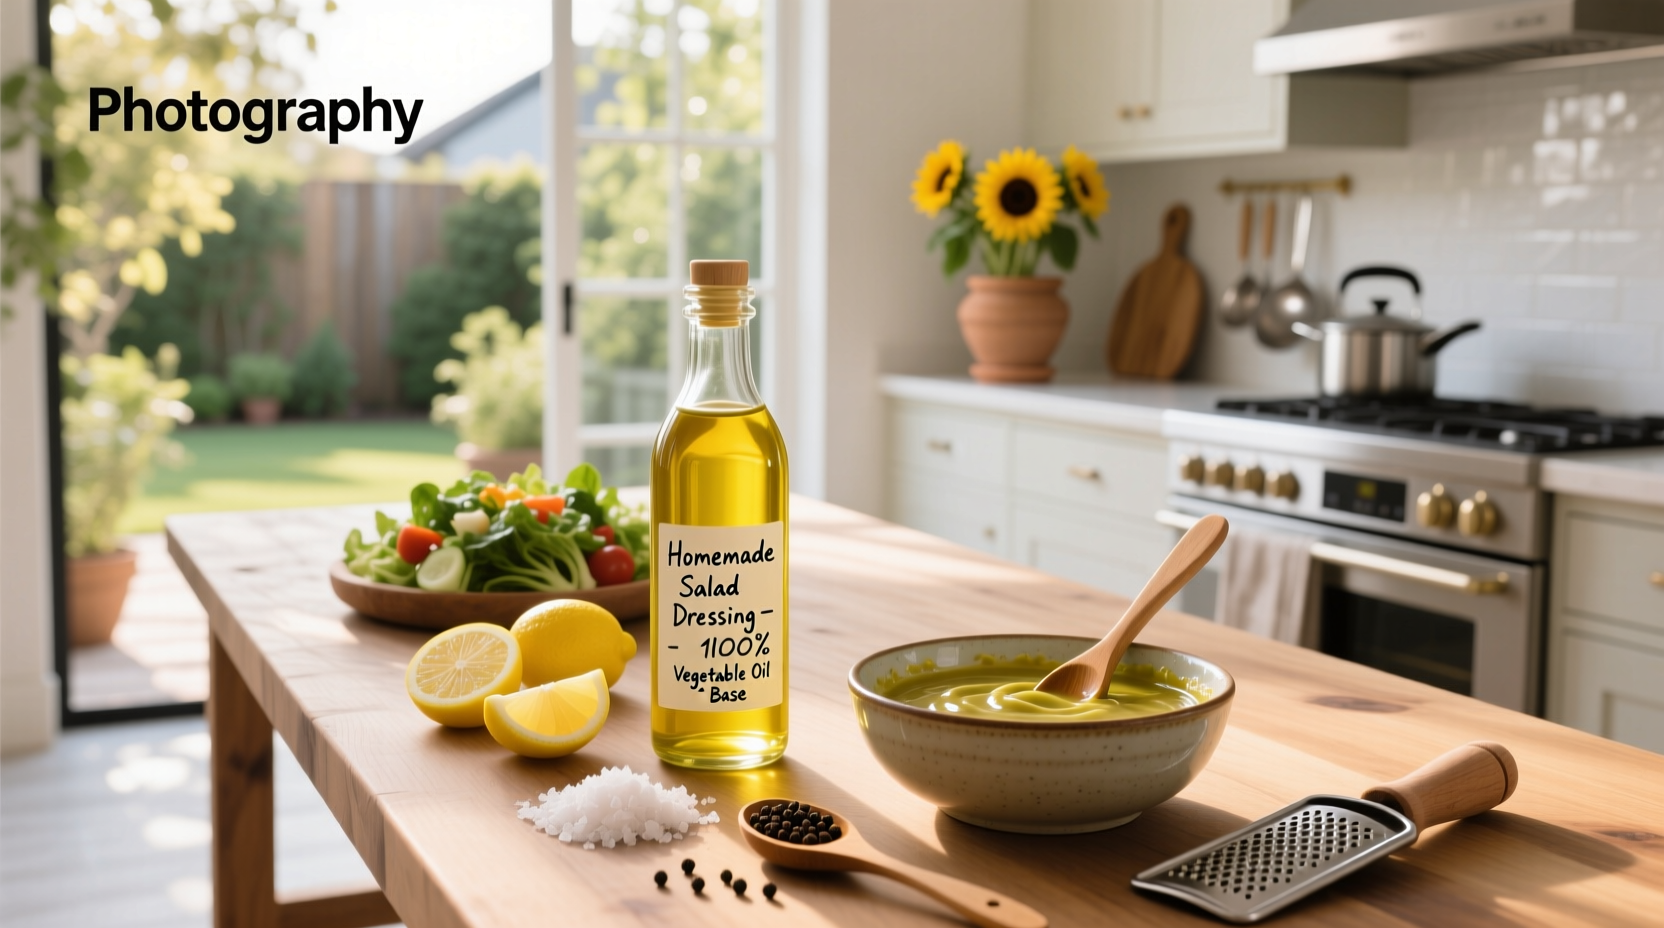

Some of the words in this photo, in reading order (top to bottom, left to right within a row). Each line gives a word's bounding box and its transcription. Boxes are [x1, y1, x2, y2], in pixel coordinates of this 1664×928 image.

[668, 539, 775, 567] Homemade
[679, 573, 740, 598] Salad
[673, 663, 746, 690] Vegetable
[751, 661, 770, 680] Oil
[709, 686, 747, 703] Base
